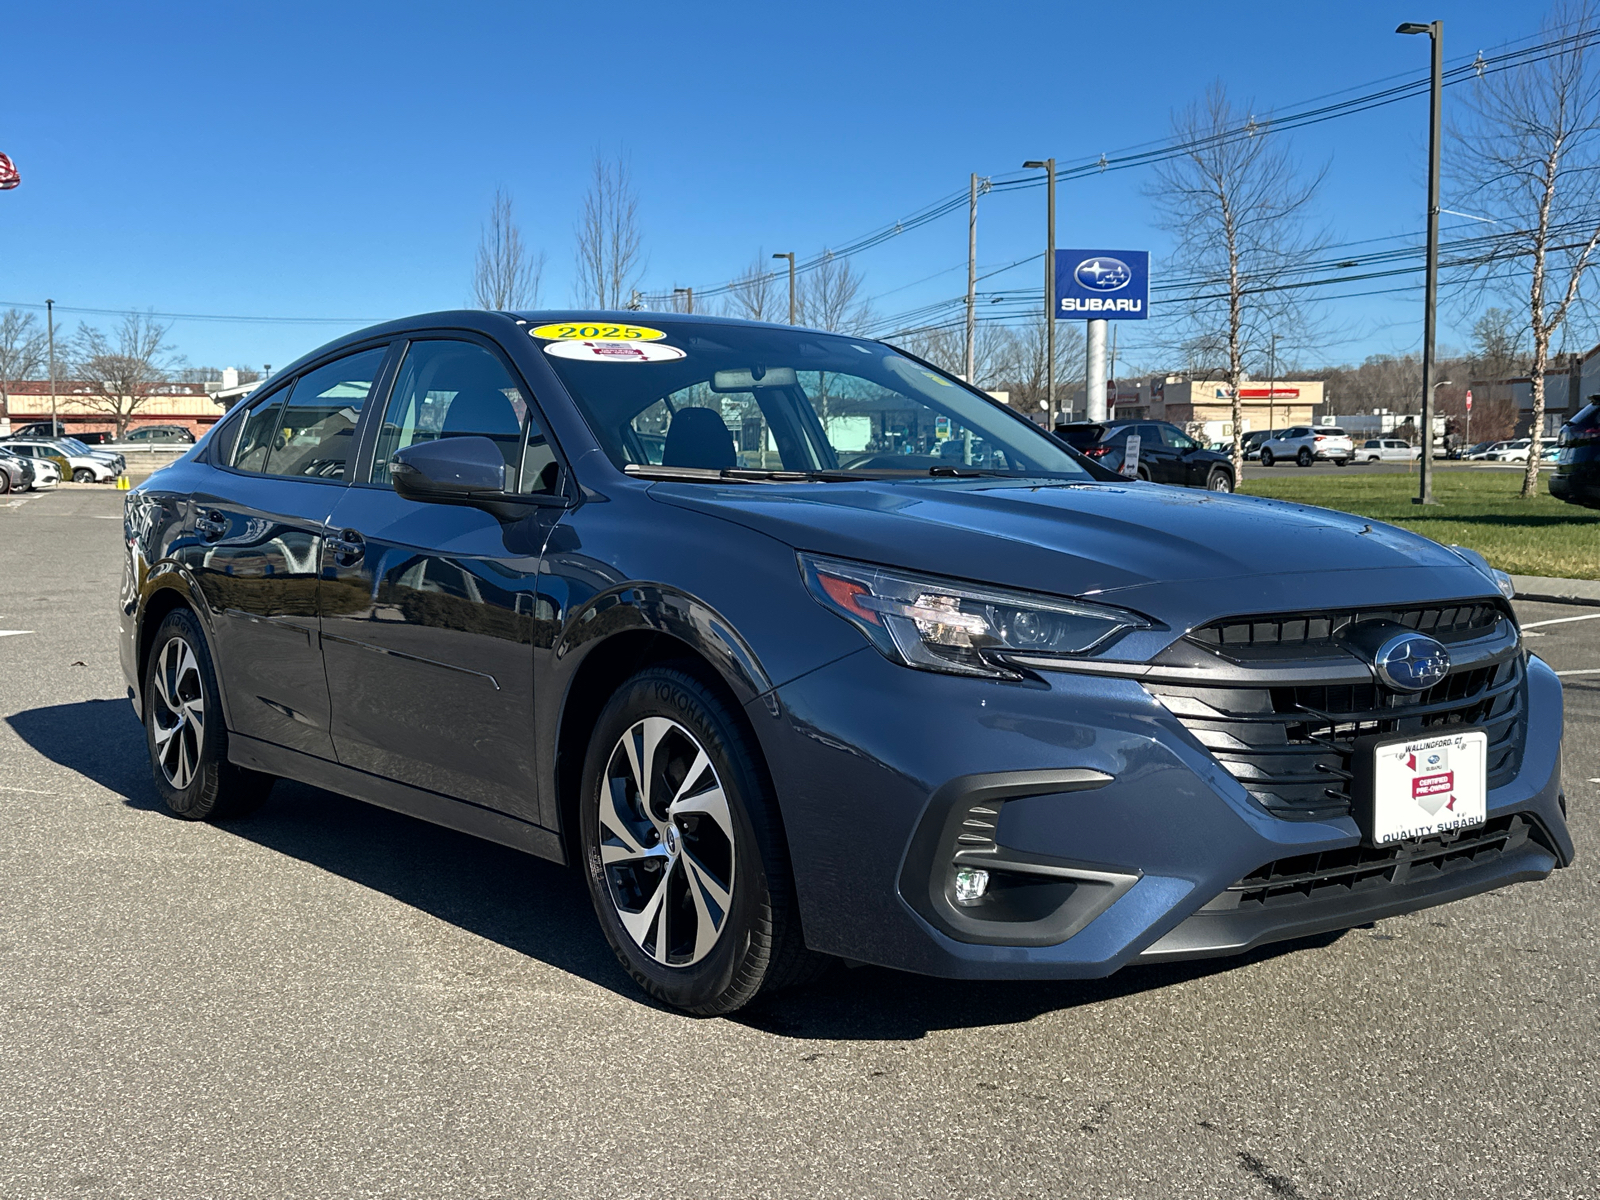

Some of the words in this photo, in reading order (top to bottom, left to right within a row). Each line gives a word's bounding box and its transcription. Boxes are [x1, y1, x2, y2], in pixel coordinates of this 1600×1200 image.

[1061, 298, 1142, 312] SUBARU
[558, 326, 642, 339] 2025
[654, 681, 726, 759] YOKOHAMA
[1455, 736, 1463, 744] CT
[1419, 776, 1448, 786] CERTIFIED
[1416, 783, 1451, 794] PRE-OWNED
[1382, 825, 1432, 842] QUALITY
[1437, 816, 1483, 832] SUBARU
